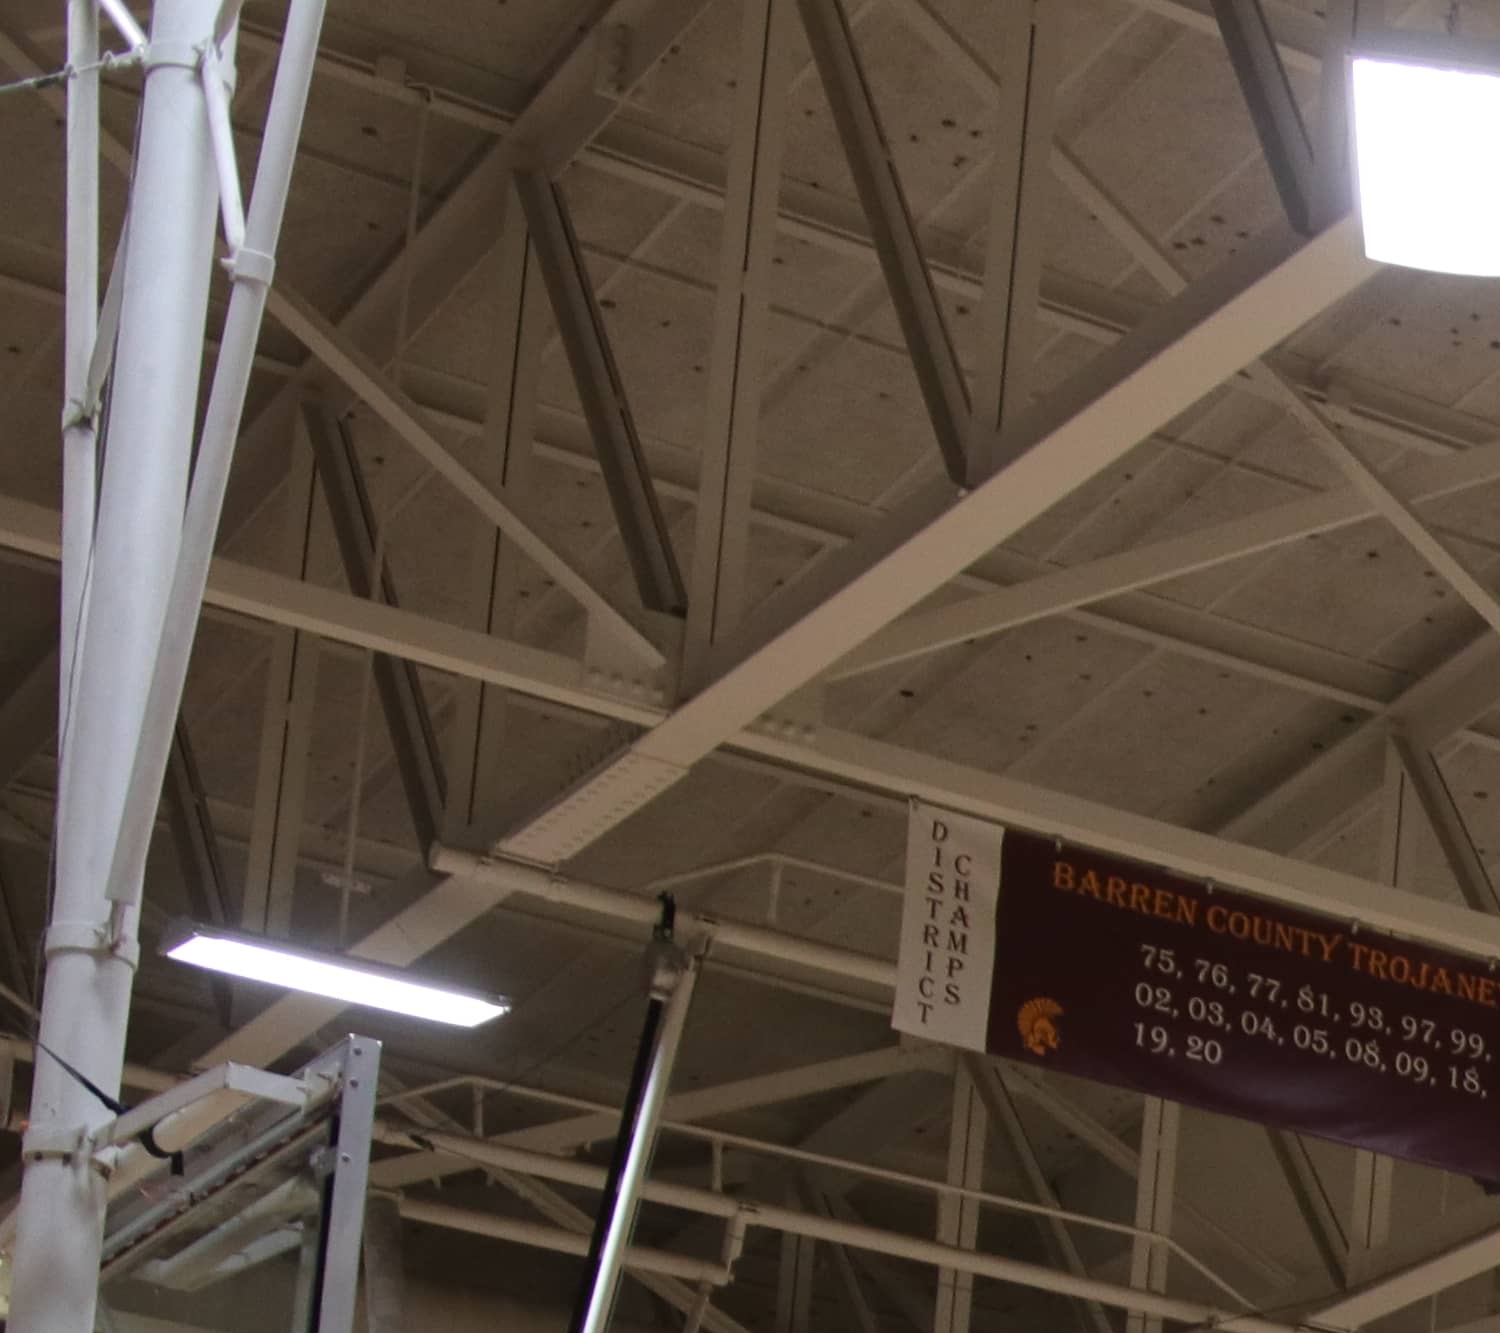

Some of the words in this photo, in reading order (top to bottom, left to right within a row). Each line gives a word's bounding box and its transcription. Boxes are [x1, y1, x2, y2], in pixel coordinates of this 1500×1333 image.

[917, 820, 948, 1024] DISTRICT
[944, 852, 971, 1005] CHAMPS
[1053, 862, 1199, 926] BARREN
[1206, 905, 1343, 961] COUNTY
[1135, 982, 1179, 1018] 02,
[1188, 997, 1231, 1032] 03,
[1241, 1011, 1284, 1046] 04,
[1293, 1025, 1336, 1059] 05,
[1345, 1038, 1387, 1072] 08,
[1395, 1051, 1436, 1086] 09,
[1449, 1066, 1488, 1099] 18,
[1135, 1022, 1176, 1057] 19,
[1185, 1035, 1223, 1064] 20
[1141, 944, 1183, 978] 75,
[1196, 959, 1236, 994] 76,
[1248, 973, 1288, 1008] 77,
[1297, 984, 1340, 1022] 81,
[1350, 1002, 1391, 1035] 93,
[1401, 1015, 1441, 1049] 97,
[1450, 1029, 1491, 1062] 99,
